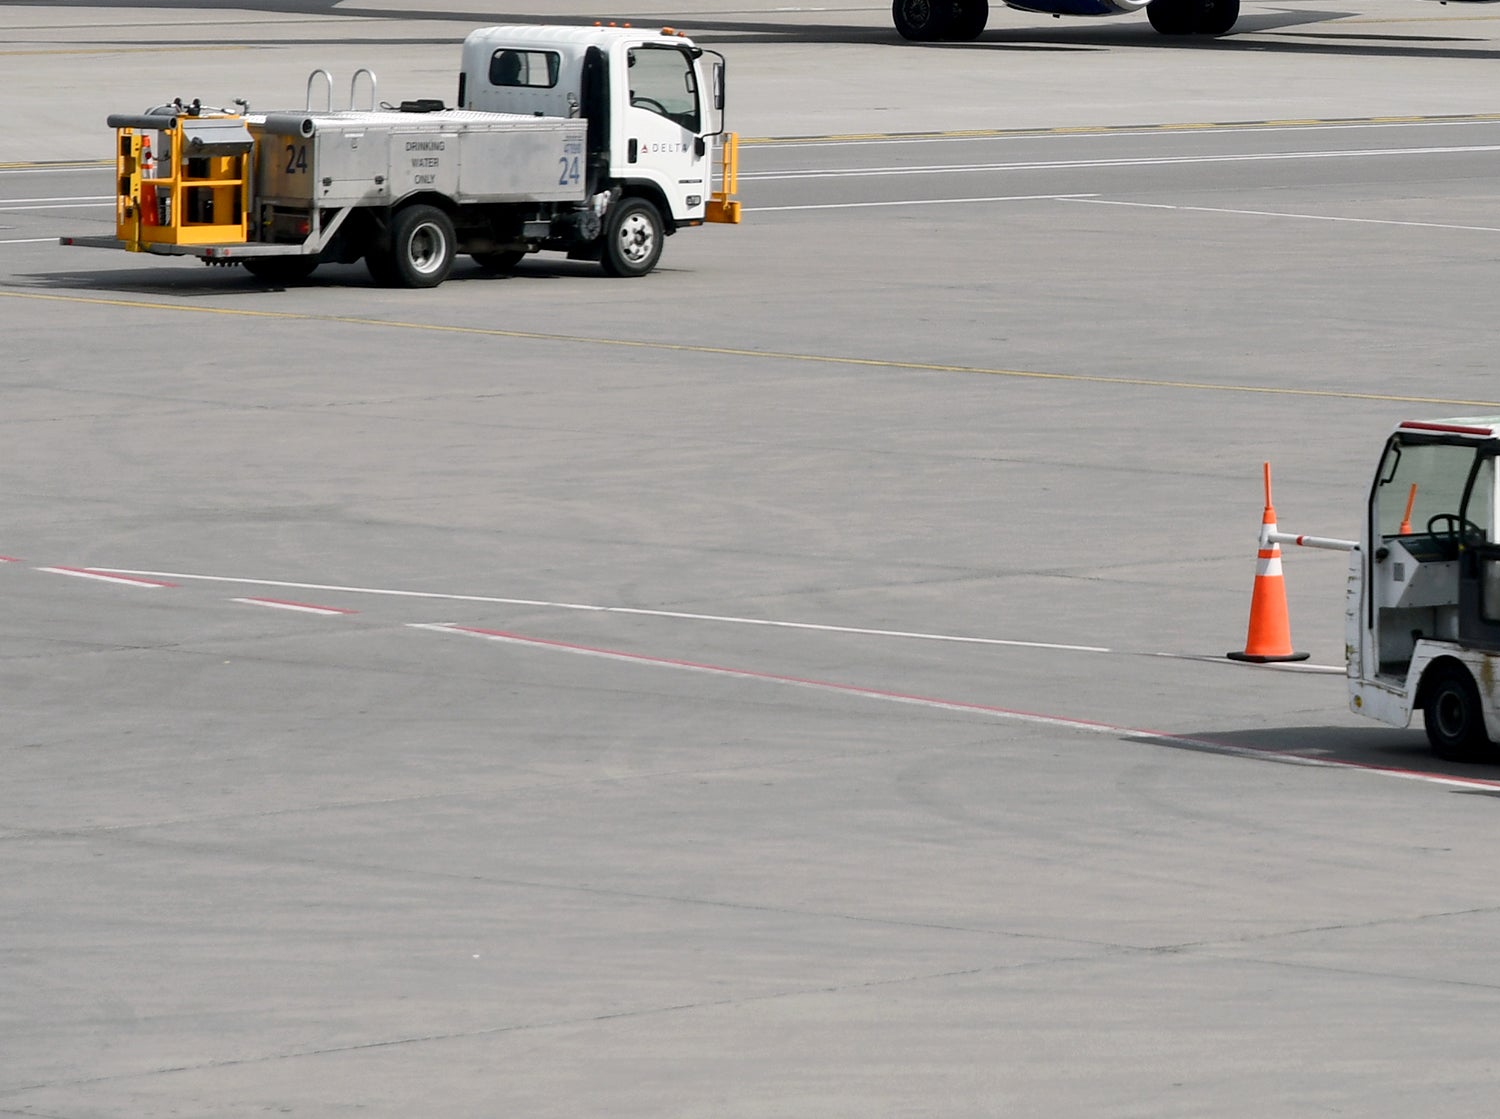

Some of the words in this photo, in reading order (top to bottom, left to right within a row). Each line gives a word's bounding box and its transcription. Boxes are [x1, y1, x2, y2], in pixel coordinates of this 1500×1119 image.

[405, 140, 446, 152] DRINKING
[652, 143, 687, 153] DELTA
[285, 144, 308, 174] 24
[411, 157, 440, 168] WATER
[558, 156, 580, 186] 24
[414, 174, 436, 185] ONLY
